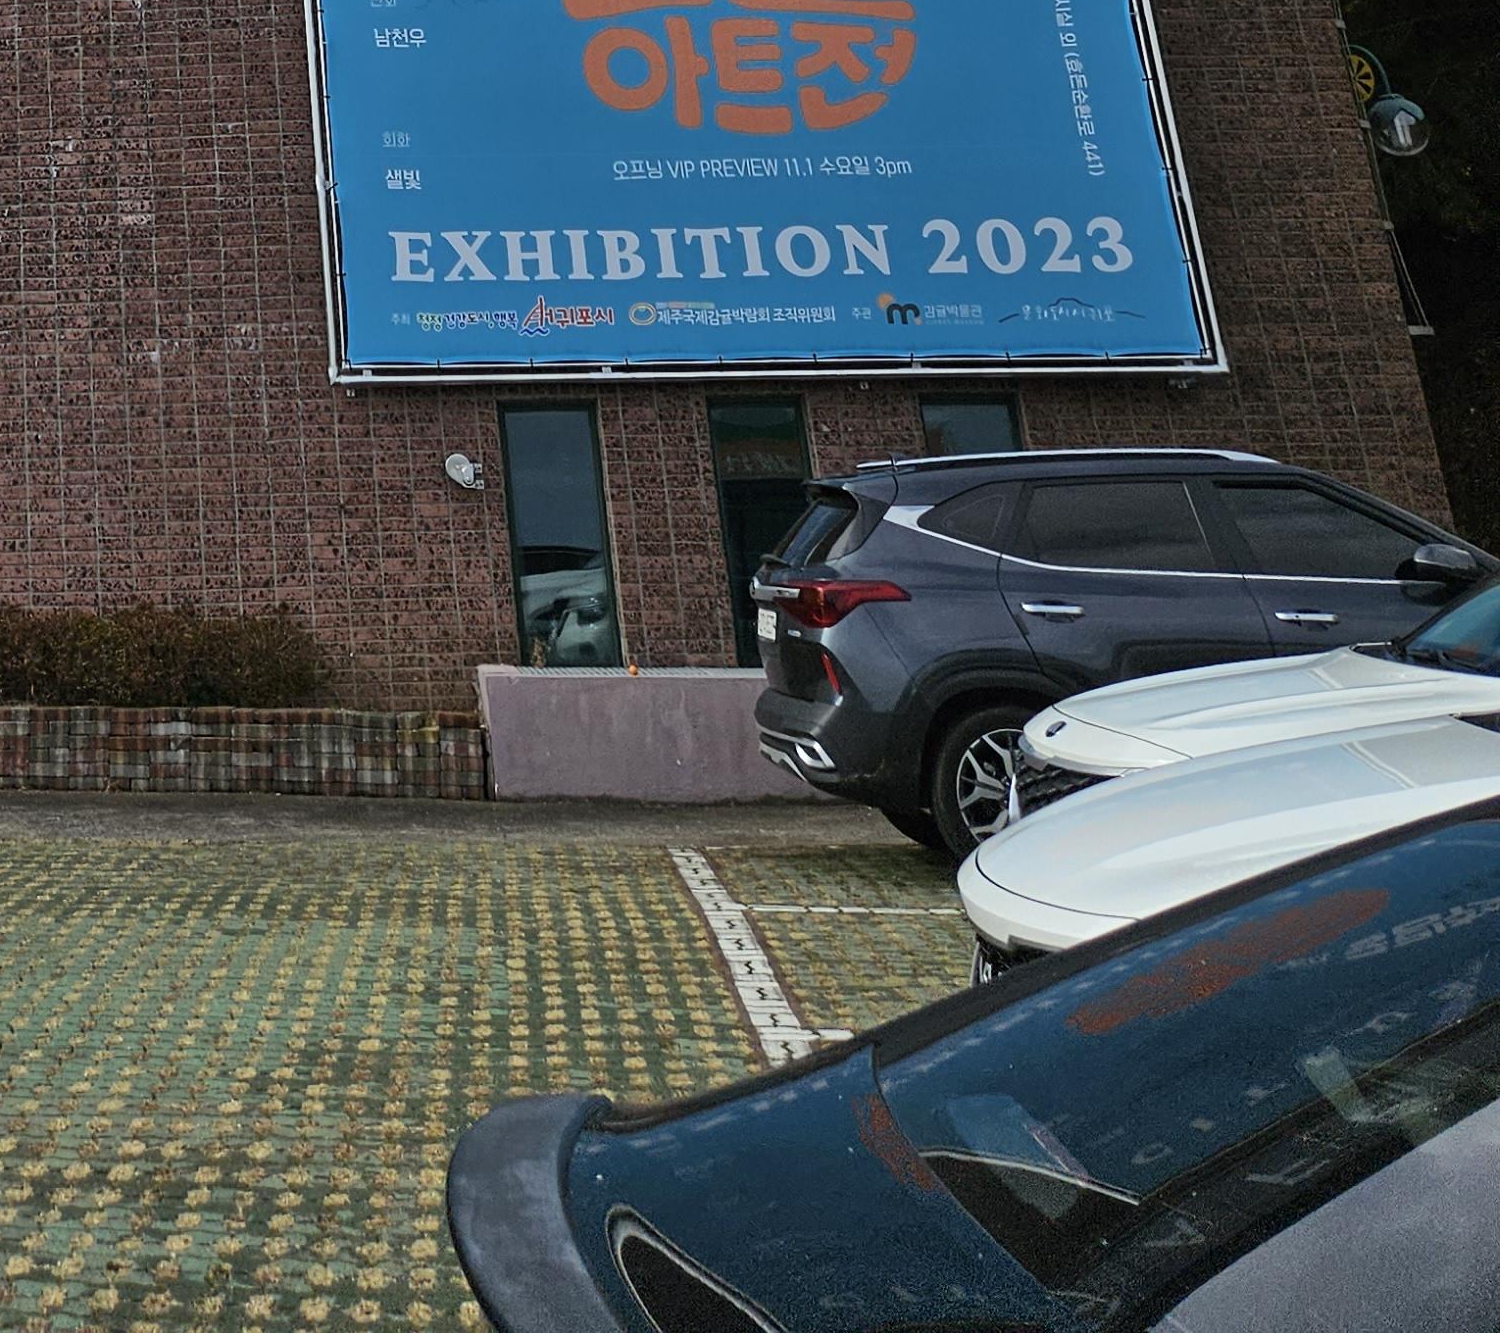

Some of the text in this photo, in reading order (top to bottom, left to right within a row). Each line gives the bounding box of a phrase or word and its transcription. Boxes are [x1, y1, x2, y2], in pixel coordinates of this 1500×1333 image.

[373, 28, 426, 48] 남천우
[582, 15, 916, 134] 아트전
[613, 156, 912, 180] 오프닝 VIP PREVIEW 11.1 수요일 3pm
[388, 216, 1133, 281] EXHIBITION 2023
